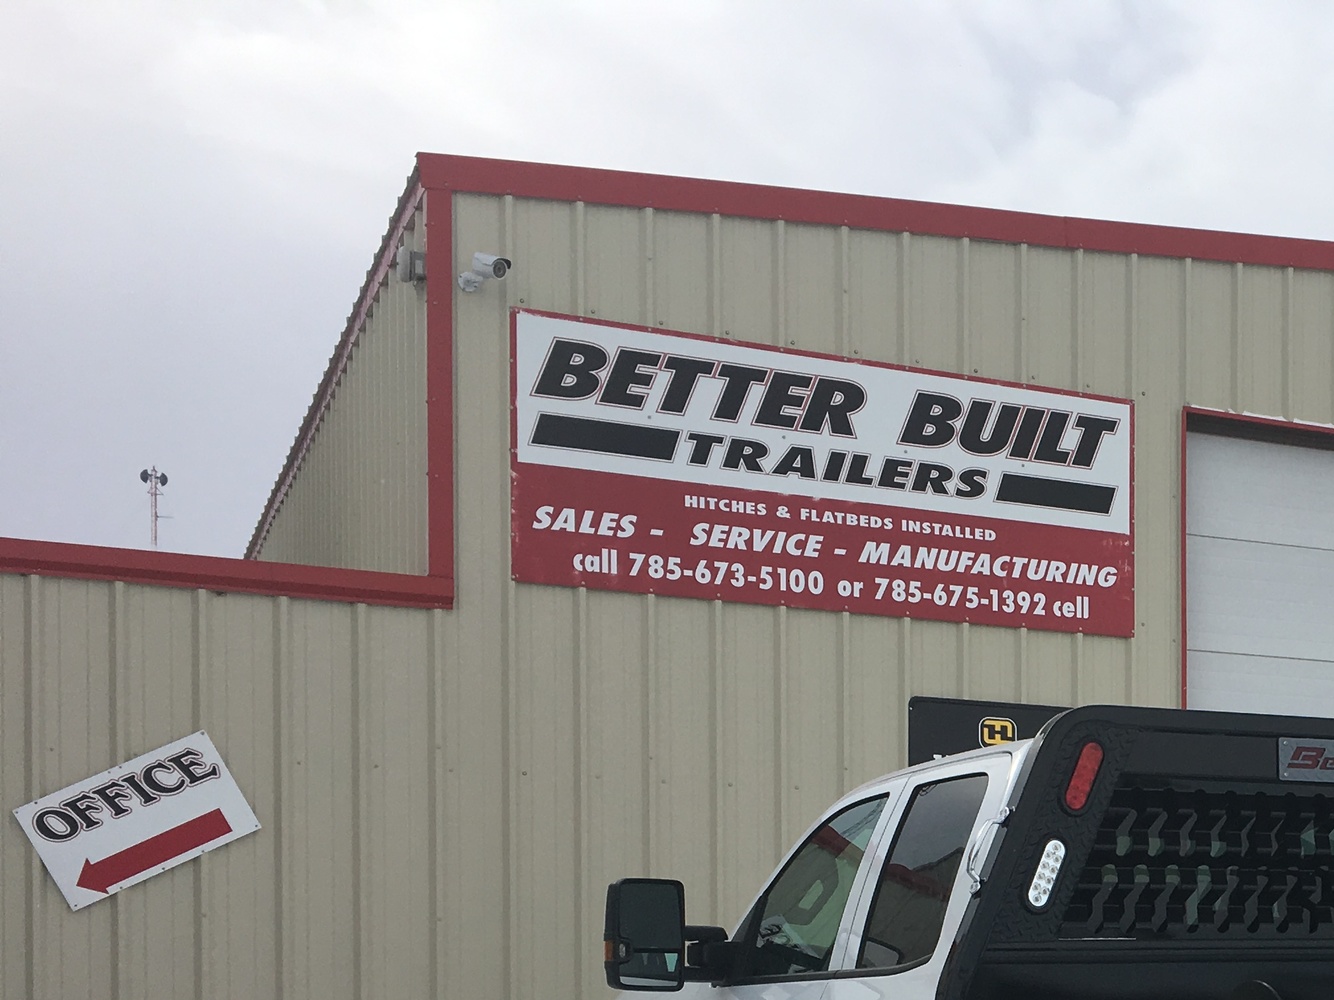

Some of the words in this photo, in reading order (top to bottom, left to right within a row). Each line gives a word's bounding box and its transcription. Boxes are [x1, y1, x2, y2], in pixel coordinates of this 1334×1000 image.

[530, 336, 867, 439] BETTER
[896, 390, 1121, 470] BUILT
[684, 430, 990, 499] TRAILERS
[532, 505, 637, 538] SALES
[690, 522, 824, 558] SERVICE
[858, 541, 1118, 588] MANUFACTURING
[685, 495, 767, 516] HITCHES
[776, 505, 791, 519] &
[801, 508, 893, 530] FLATBEDS
[902, 519, 997, 542] INSTALLED
[573, 548, 618, 575] call
[629, 553, 824, 595] 785-673-5100
[837, 579, 863, 598] or
[874, 578, 1046, 616] 785-675-1392
[1053, 596, 1089, 619] cell
[32, 747, 220, 843] OFFICE
